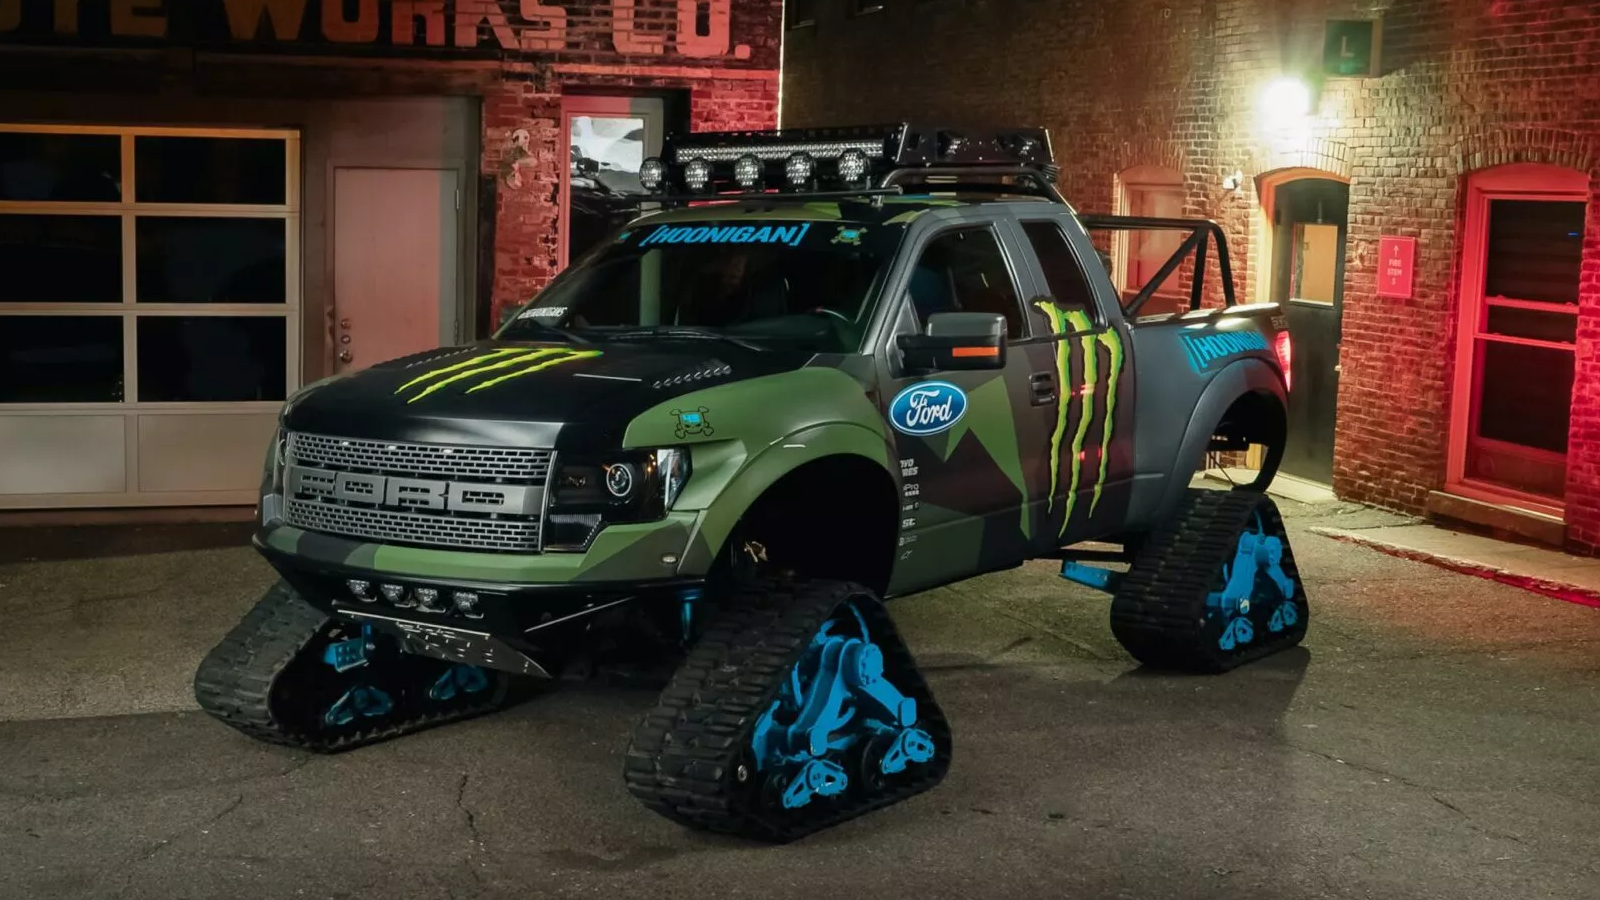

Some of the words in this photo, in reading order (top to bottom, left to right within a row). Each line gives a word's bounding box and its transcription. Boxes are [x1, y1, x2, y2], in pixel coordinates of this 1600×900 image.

[221, 0, 568, 51] WORKS
[612, 0, 752, 60] CO.
[906, 389, 953, 427] Ford
